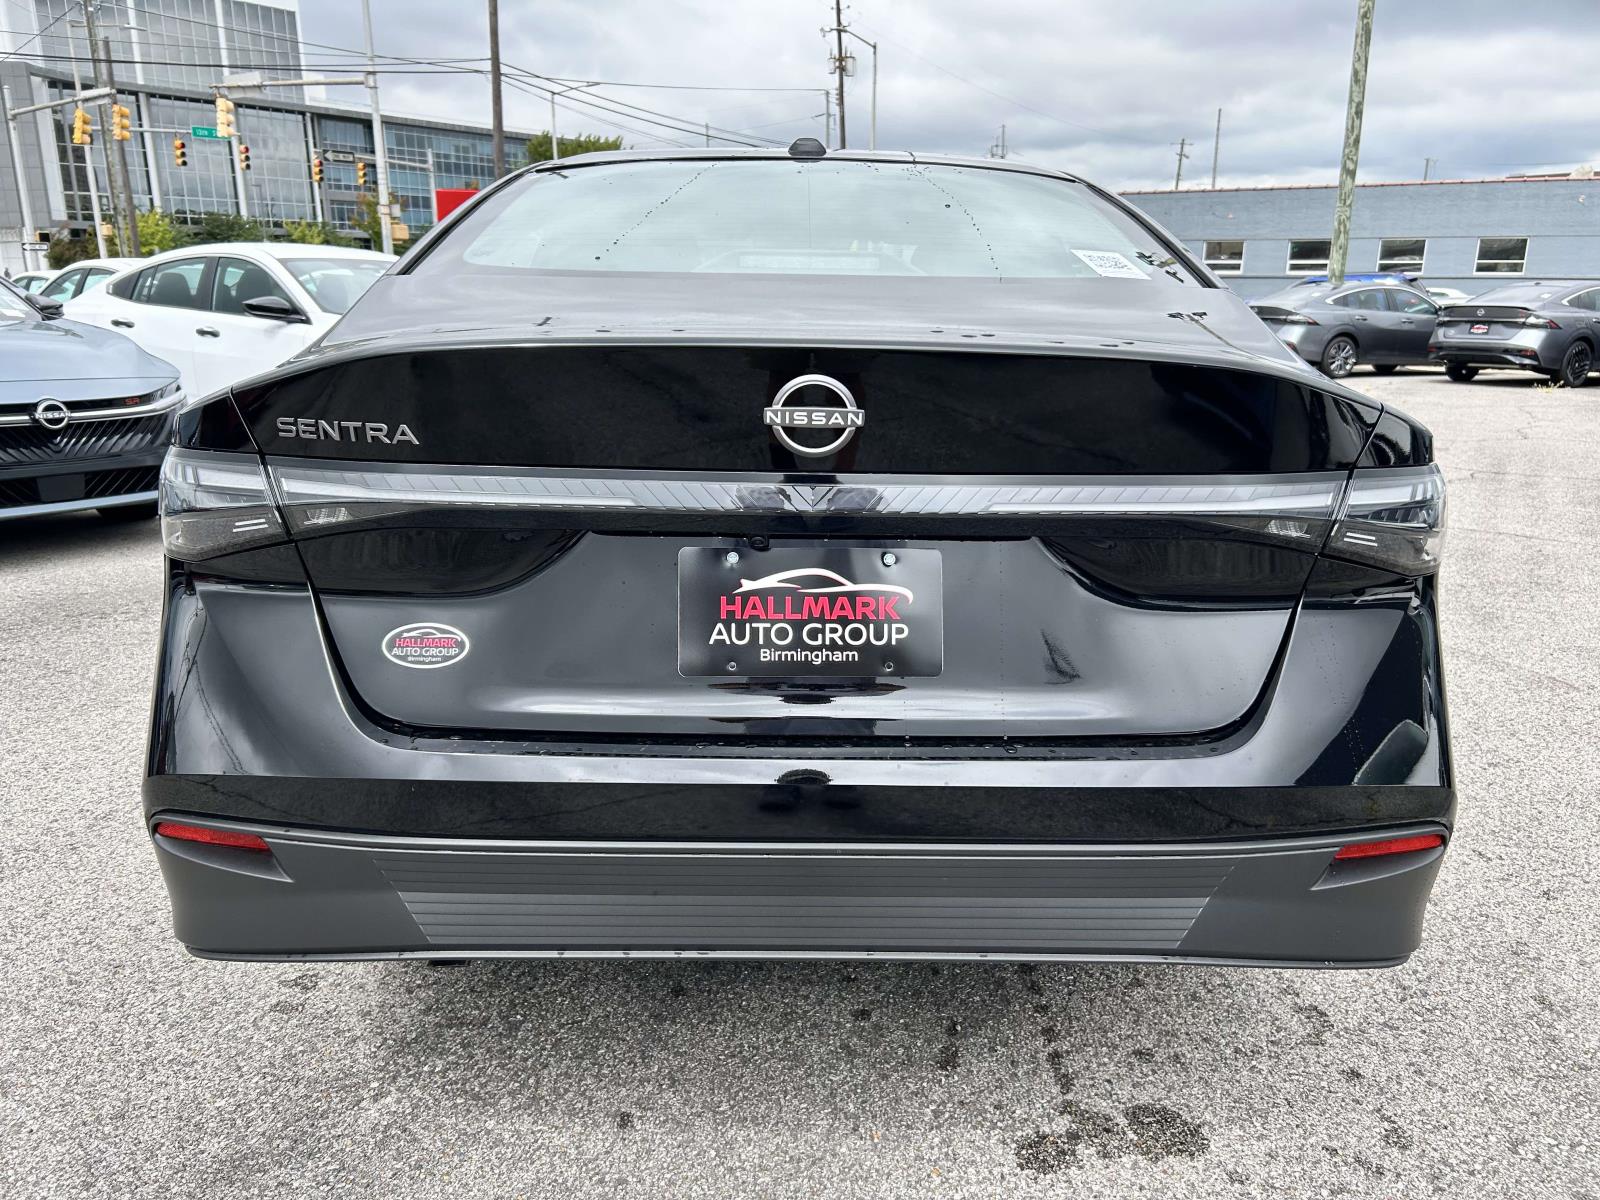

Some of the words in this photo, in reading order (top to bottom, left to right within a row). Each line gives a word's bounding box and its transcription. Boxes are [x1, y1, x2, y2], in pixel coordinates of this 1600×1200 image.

[34, 410, 72, 419] NISSAN
[766, 410, 863, 425] NISSAN
[276, 417, 420, 445] SENTRA
[720, 595, 900, 620] HALLMARK
[709, 622, 793, 645] AUTO
[802, 622, 909, 646] GROUP
[395, 638, 456, 647] HALLMARK
[391, 647, 420, 656] AUTO
[422, 647, 459, 656] GROUP
[760, 648, 859, 665] Birmingham
